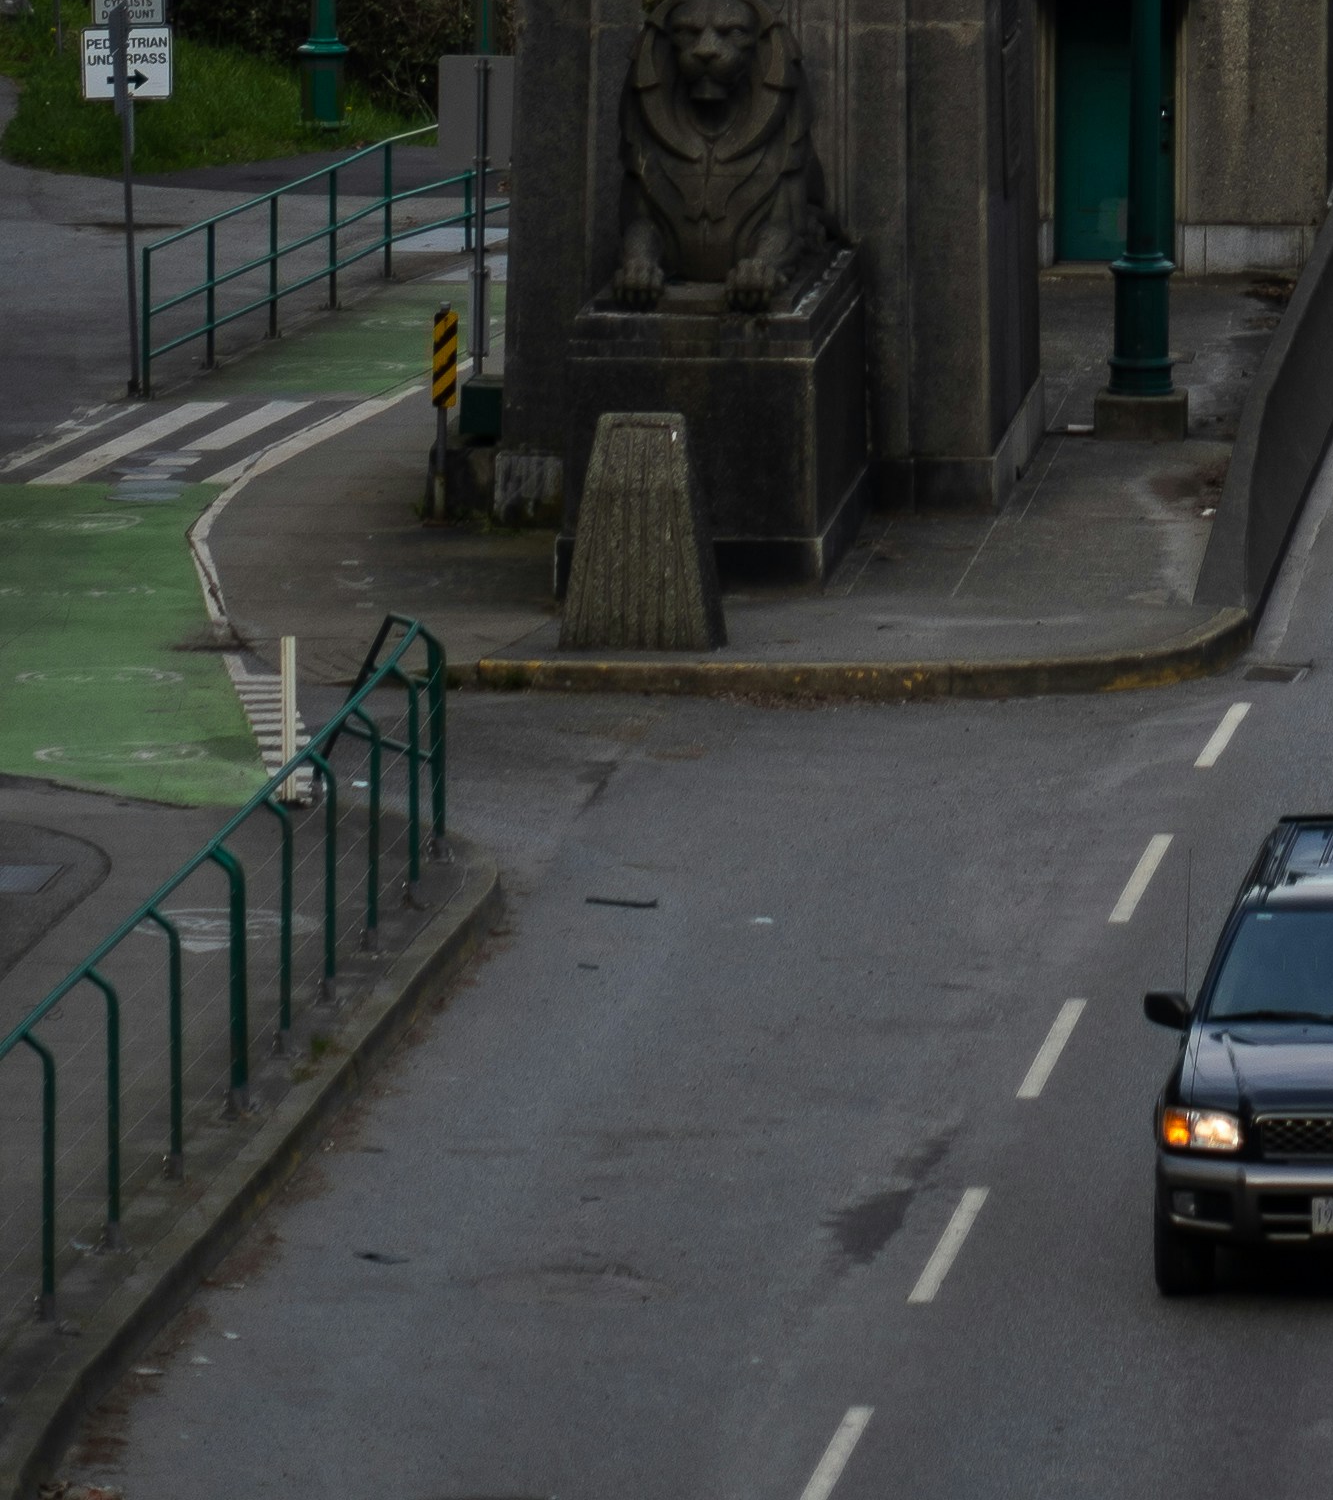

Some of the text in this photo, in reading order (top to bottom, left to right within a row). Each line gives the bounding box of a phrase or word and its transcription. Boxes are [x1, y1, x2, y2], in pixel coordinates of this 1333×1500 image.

[101, 9, 155, 20] DOUNT
[86, 37, 168, 50] PEDTRIAN
[87, 53, 167, 66] UNDRPASS
